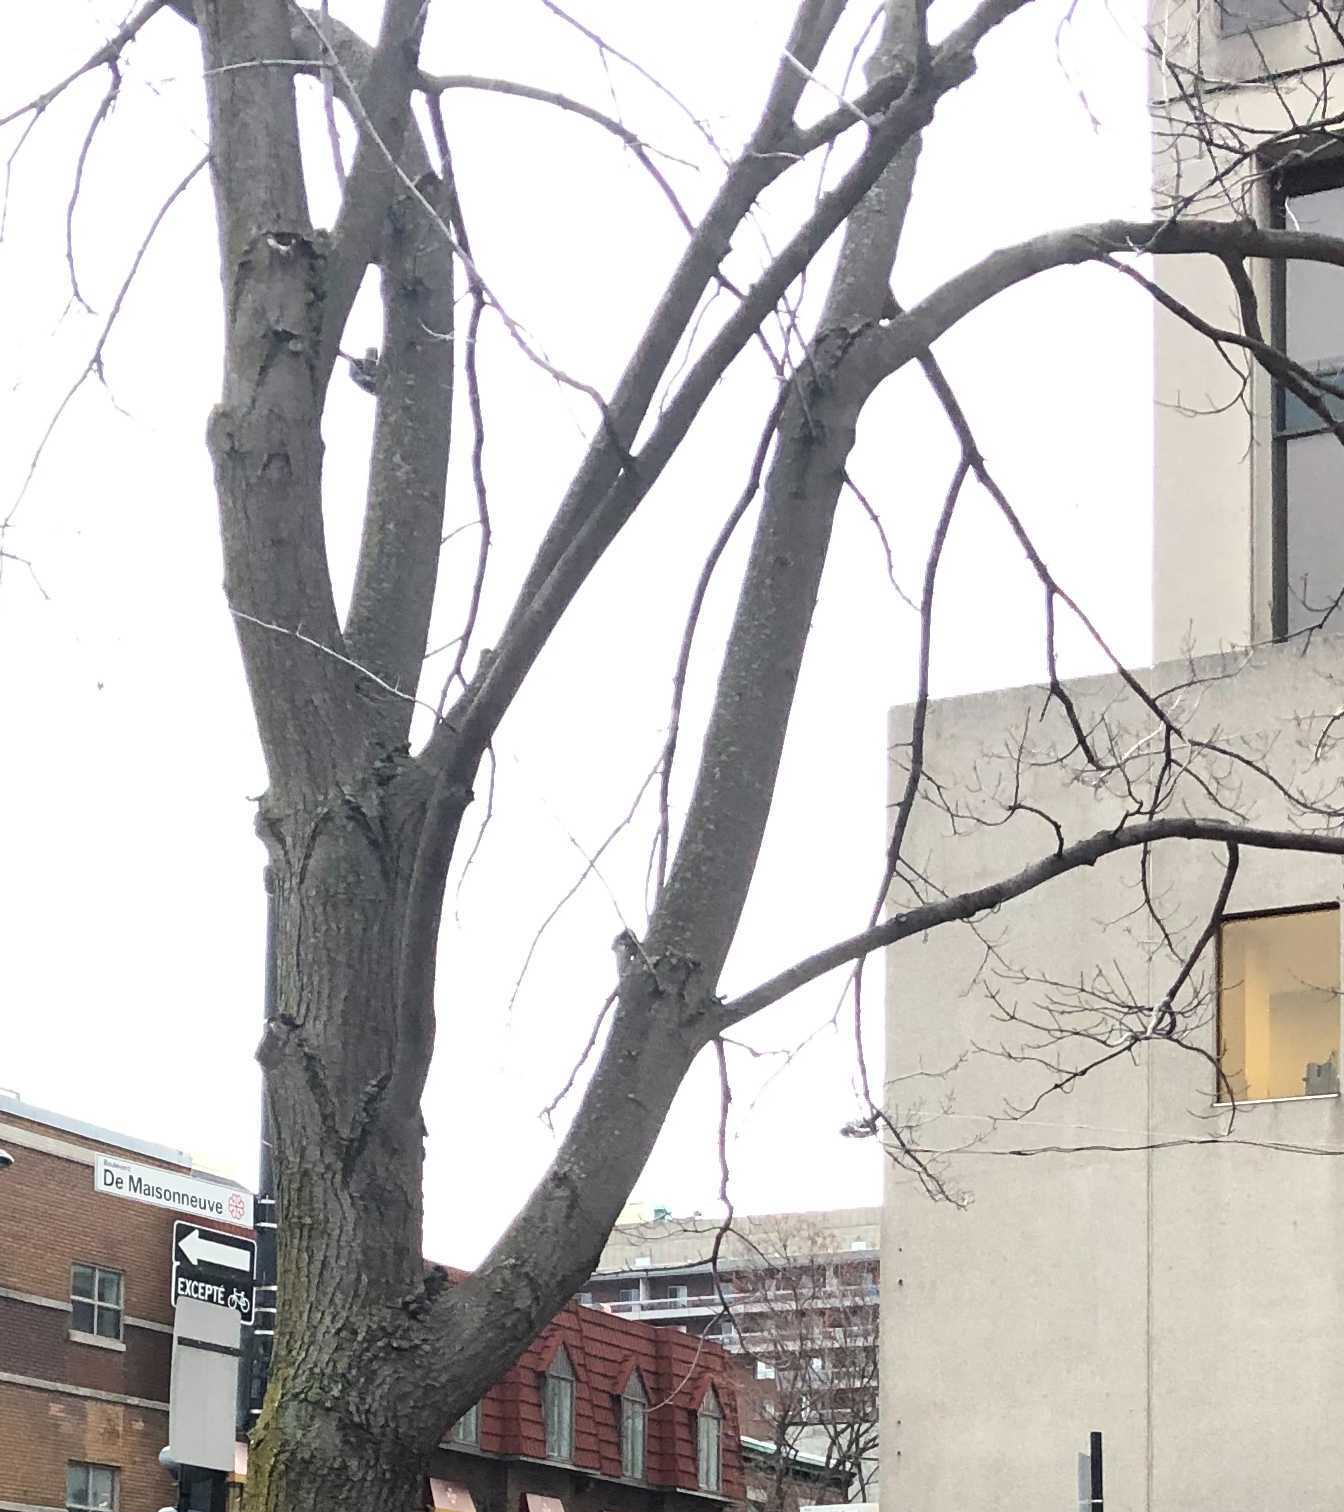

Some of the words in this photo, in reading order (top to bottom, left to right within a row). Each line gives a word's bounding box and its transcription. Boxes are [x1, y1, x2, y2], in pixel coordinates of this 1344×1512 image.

[103, 1168, 124, 1190] De
[128, 1174, 224, 1215] Maisonneuve
[177, 1276, 226, 1305] EXCEPTÉ
